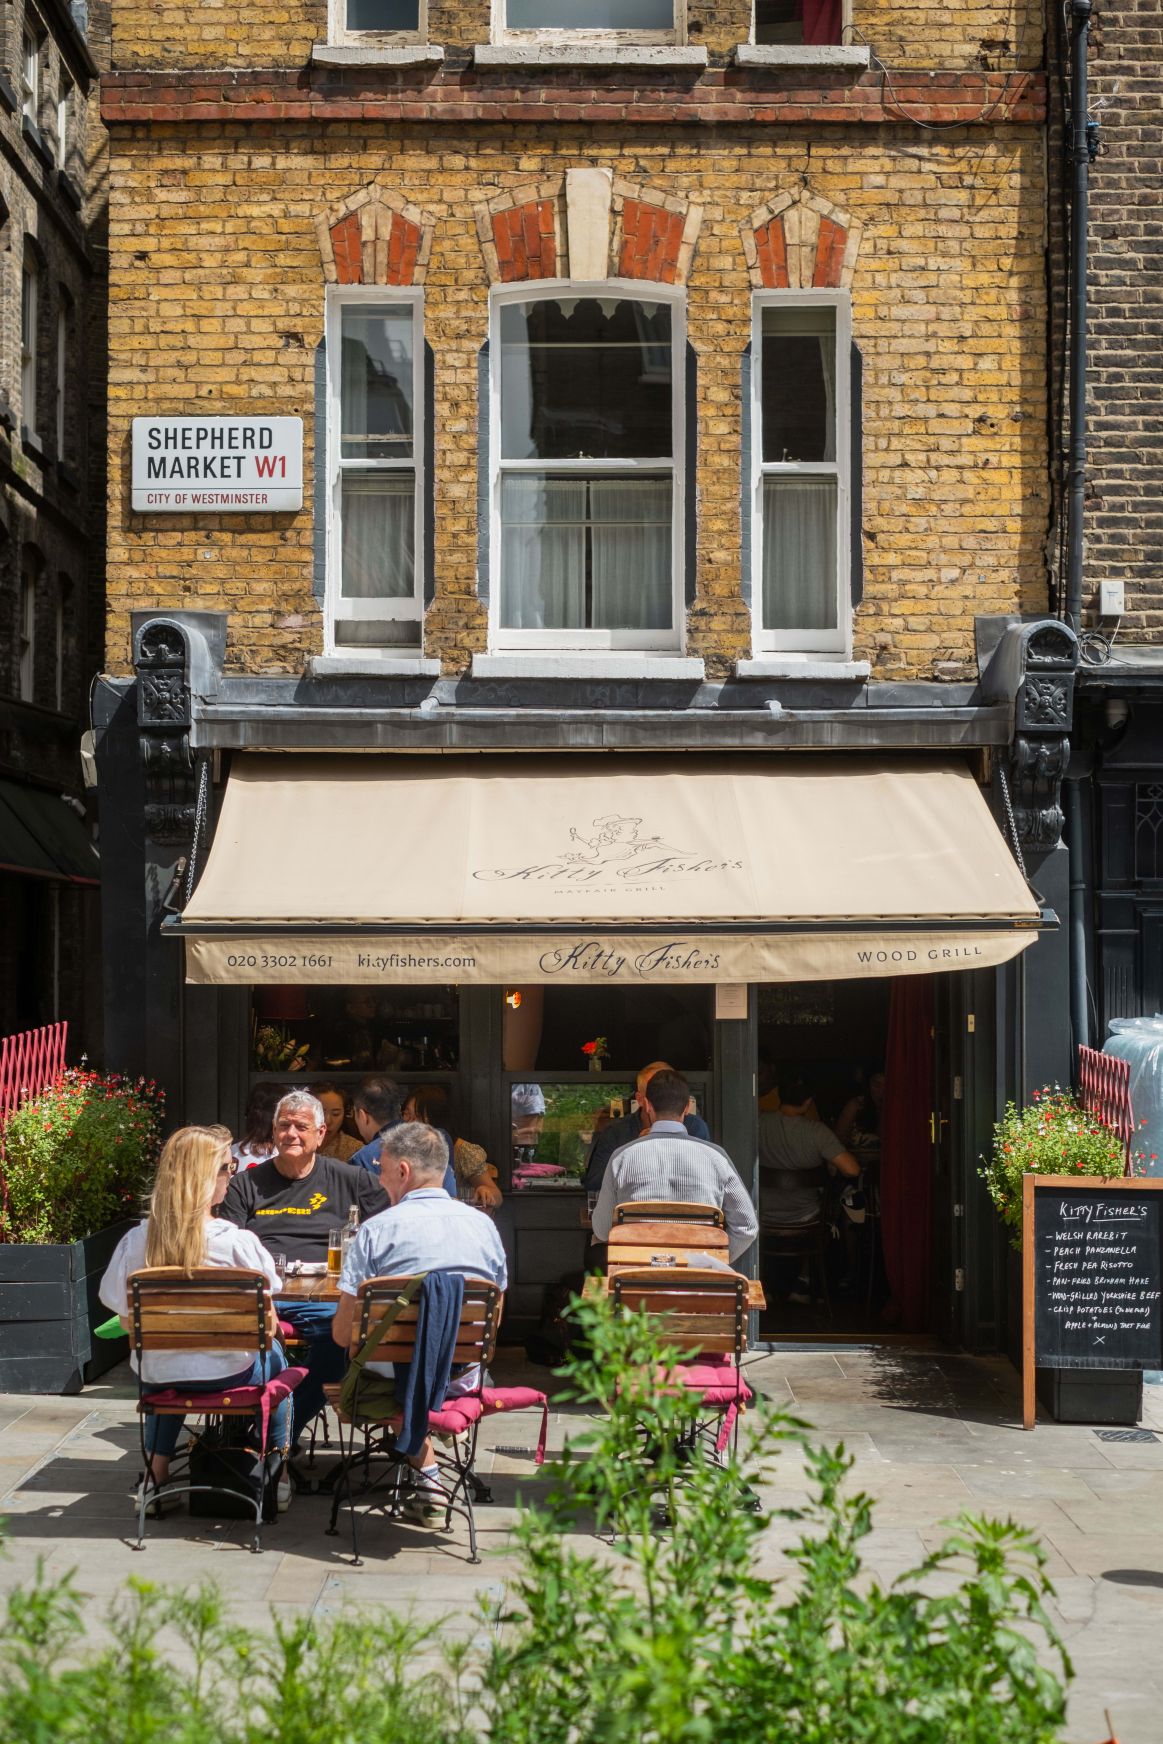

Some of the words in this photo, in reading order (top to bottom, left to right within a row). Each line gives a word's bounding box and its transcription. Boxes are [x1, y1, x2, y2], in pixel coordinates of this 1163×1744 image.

[148, 428, 273, 449] SHEPHERD
[147, 456, 246, 478] MARKET
[255, 456, 286, 477] W1
[147, 494, 170, 504] CITY
[176, 494, 188, 504] OF
[192, 494, 268, 504] WESTMINSTER
[539, 941, 626, 977] Kitty
[634, 942, 720, 979] Fisher's
[857, 950, 917, 963] WOOD
[927, 946, 982, 960] GRILL
[227, 955, 257, 967] 020
[261, 955, 297, 968] 3302
[303, 954, 332, 967] 1661
[1055, 1231, 1084, 1241] WELSH
[1053, 1246, 1081, 1256] PEACH
[1053, 1260, 1079, 1273] FRESH
[1081, 1261, 1098, 1271] PEA
[1139, 1291, 1161, 1301] BEEF
[1076, 1306, 1113, 1314] POTATOES
[1064, 1321, 1086, 1331] APPLE
